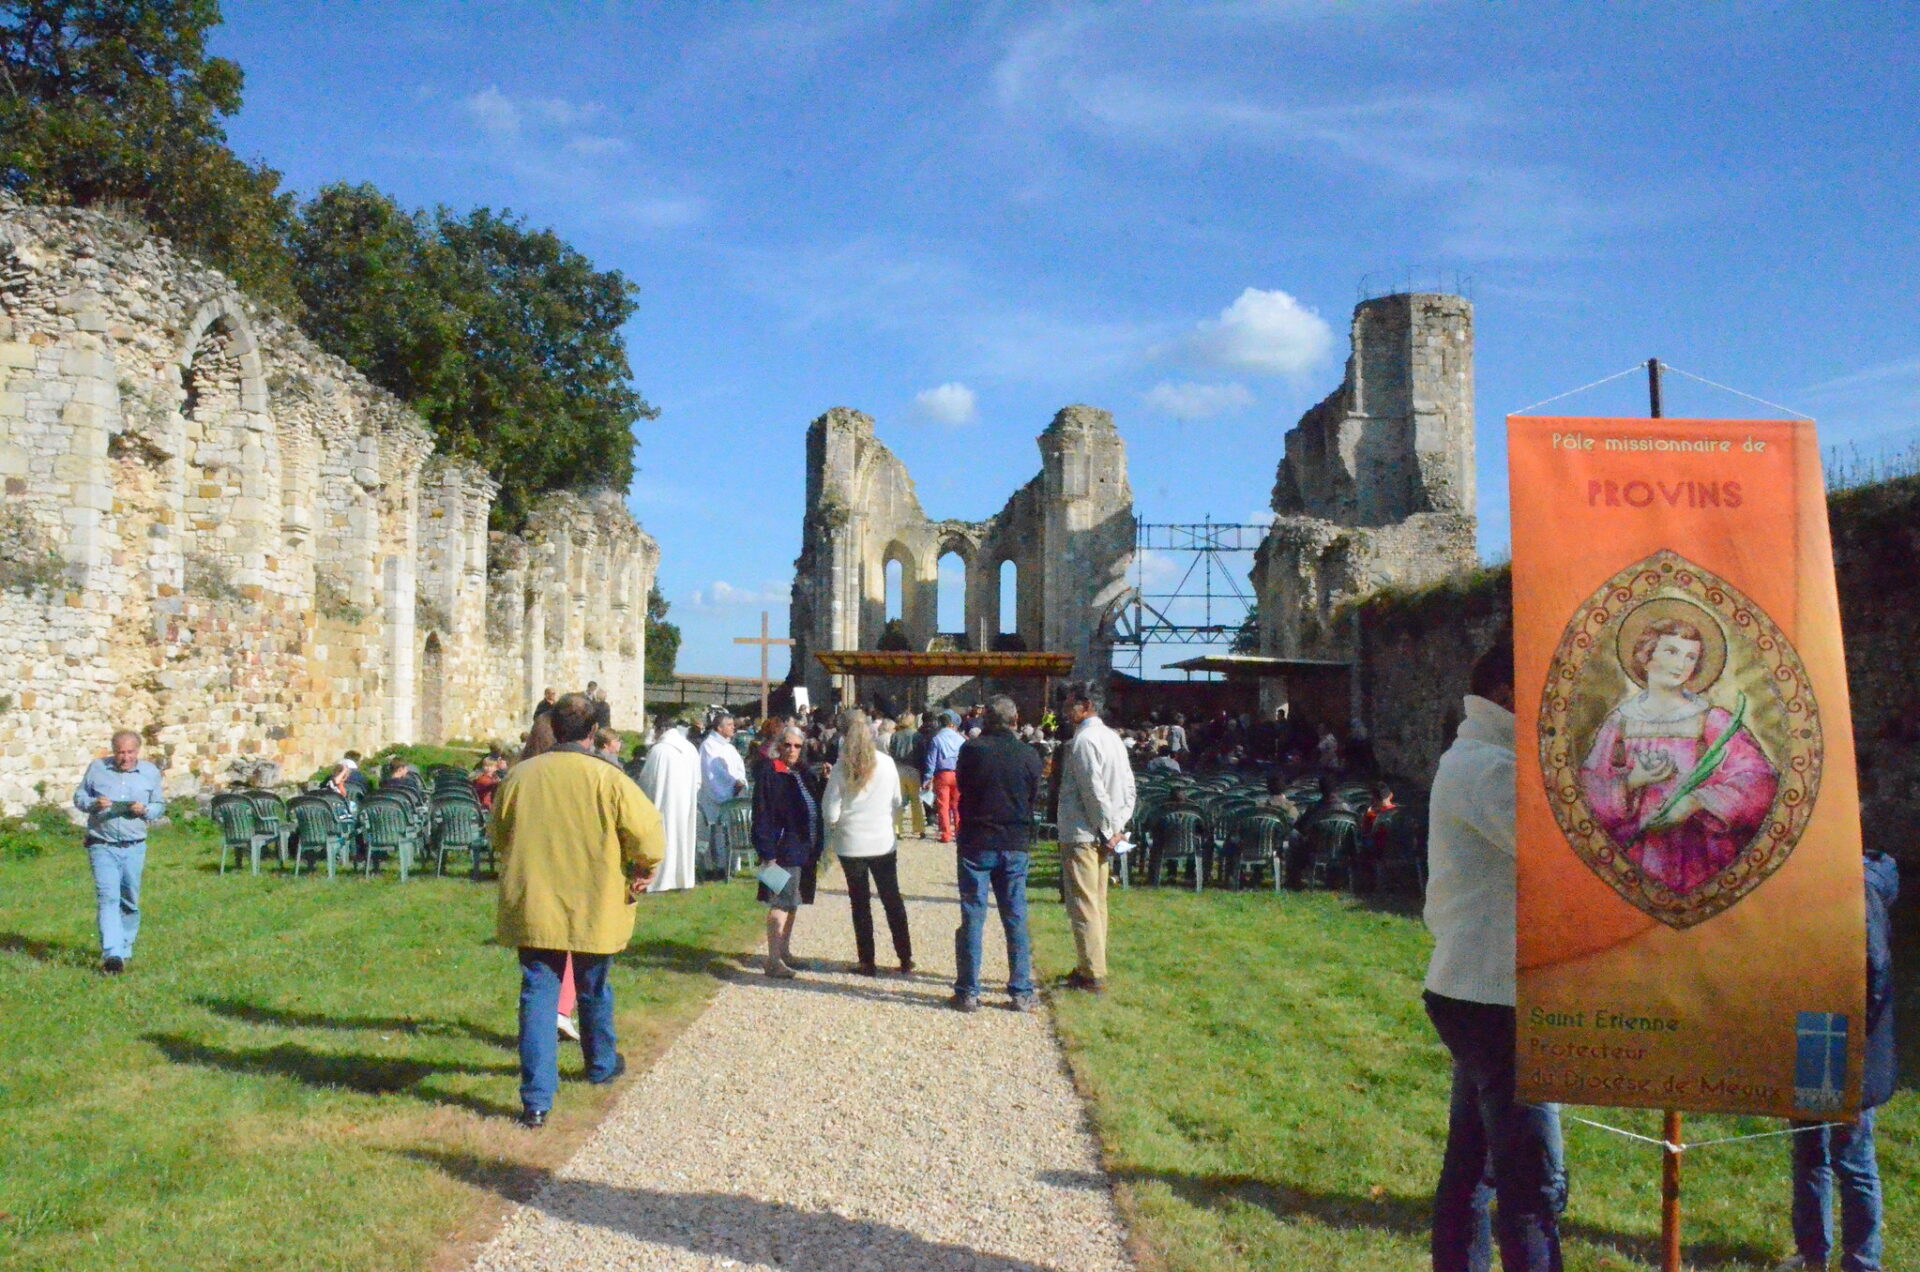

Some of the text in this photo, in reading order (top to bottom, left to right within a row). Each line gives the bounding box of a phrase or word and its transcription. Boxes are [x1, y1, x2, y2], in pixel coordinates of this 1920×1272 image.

[1552, 432, 1767, 453] Pôle missionnaire de
[1588, 479, 1744, 508] PROVINS
[1530, 1005, 1584, 1028] Saint
[1530, 1037, 1647, 1060] Protecteur
[1531, 1068, 1553, 1086] du
[1662, 1075, 1689, 1094] de
[1700, 1076, 1780, 1100] Meaux
